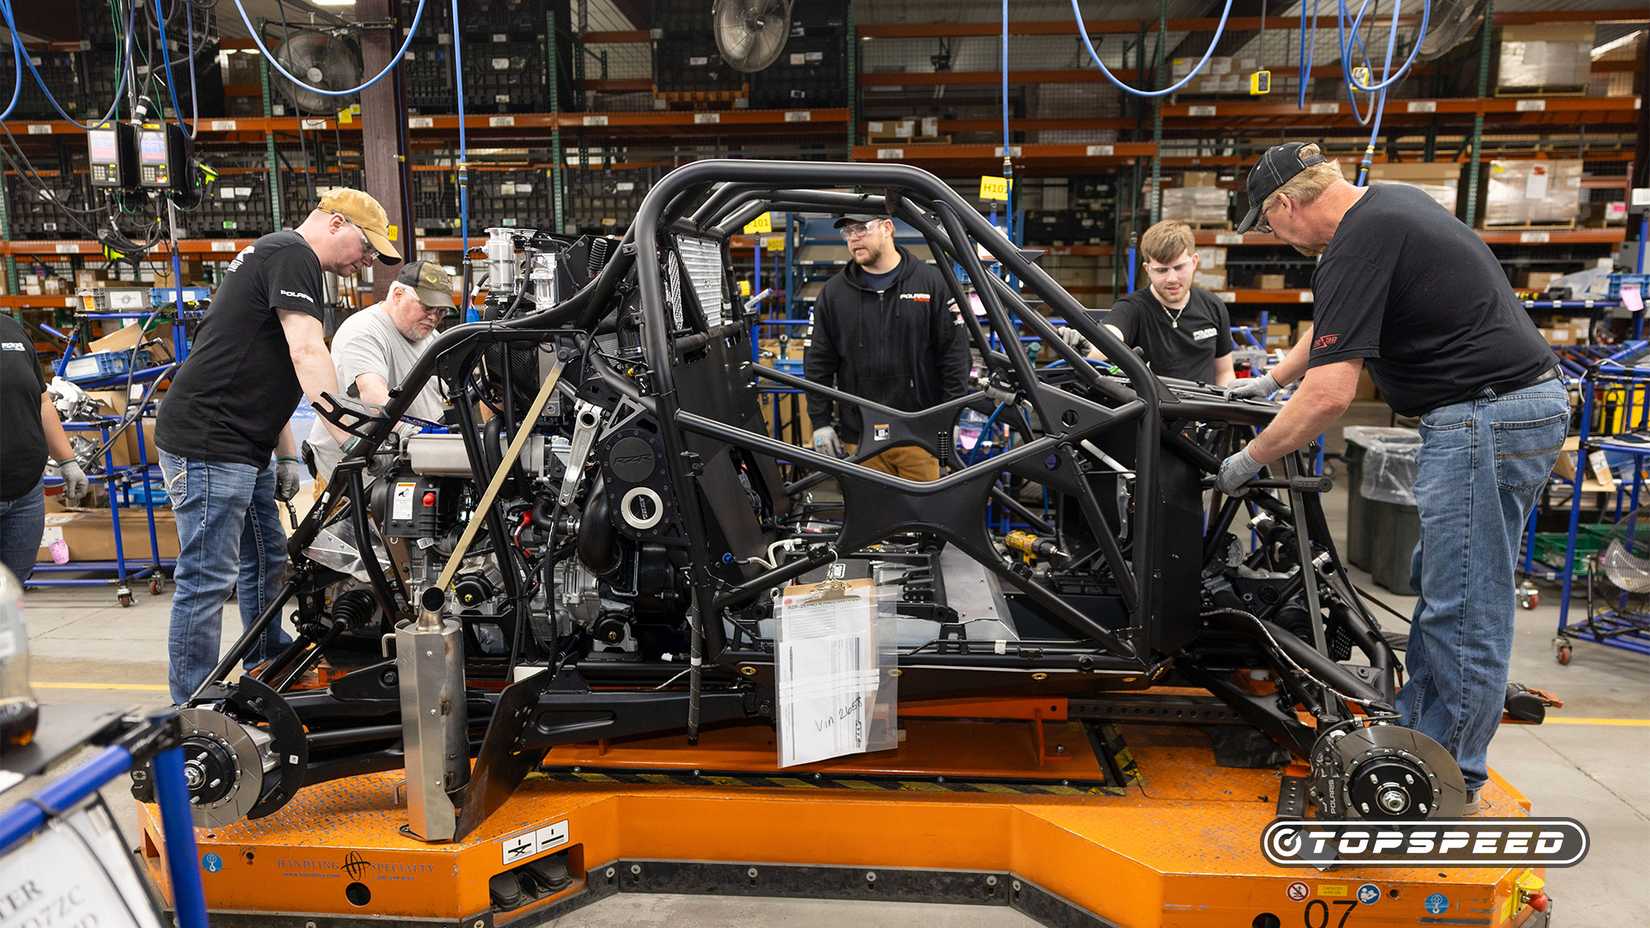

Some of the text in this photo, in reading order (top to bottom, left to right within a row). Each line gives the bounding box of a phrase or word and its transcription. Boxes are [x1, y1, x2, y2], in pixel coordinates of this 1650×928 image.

[815, 716, 834, 732] Vin
[1328, 779, 1336, 815] POLARIS
[1304, 898, 1359, 928] 07
